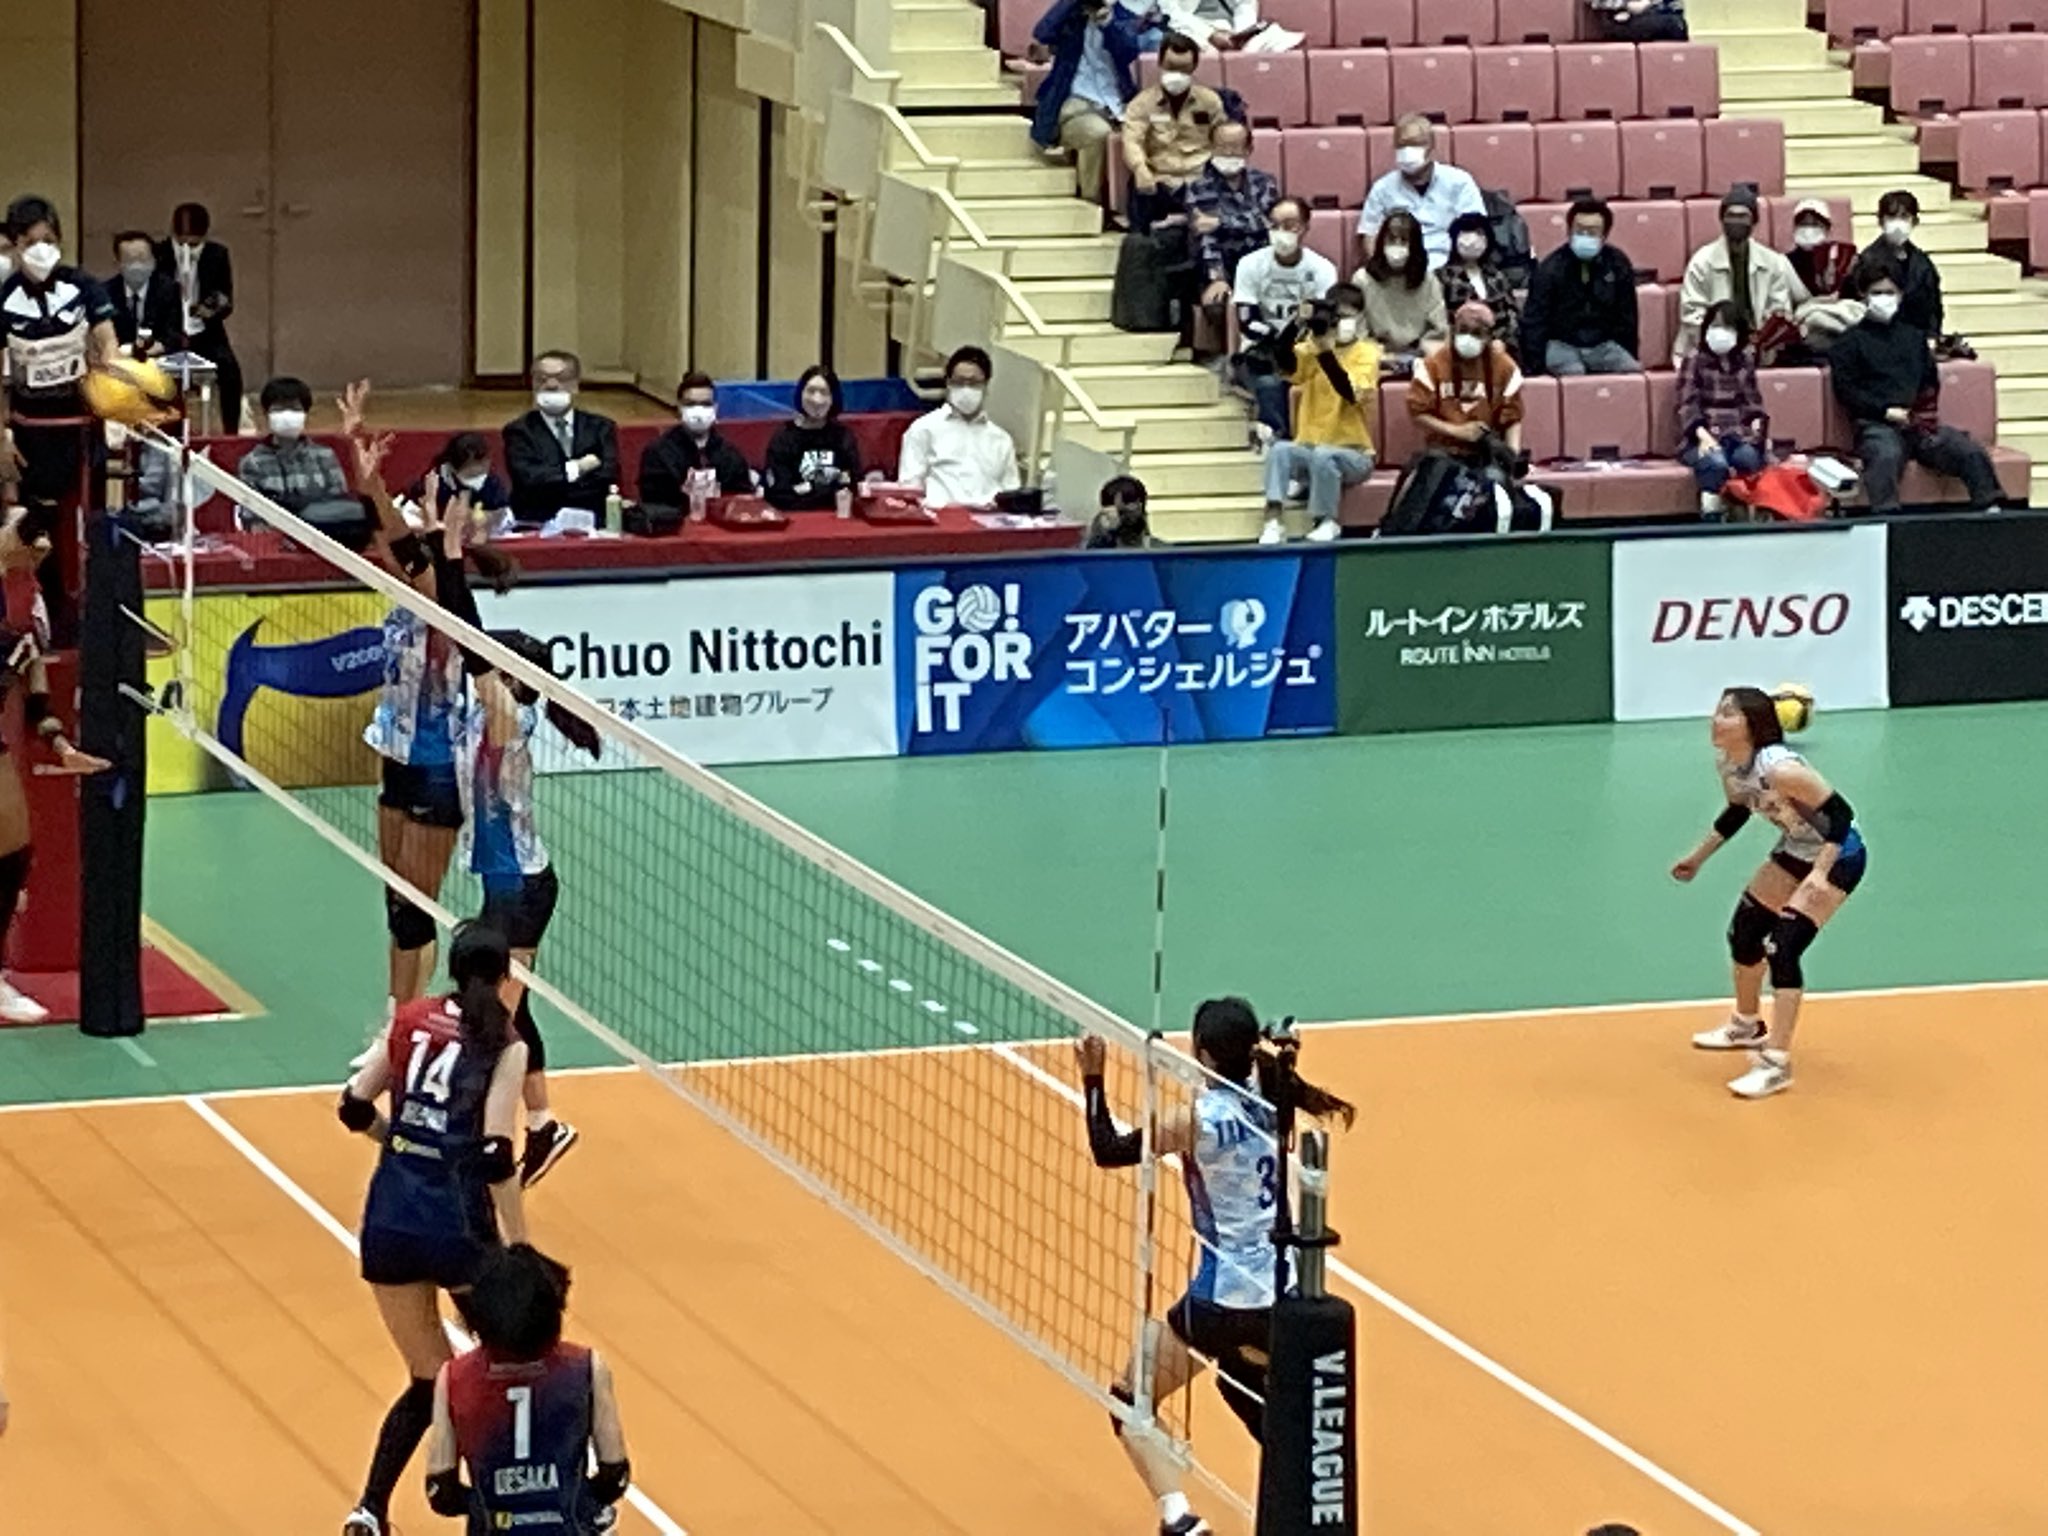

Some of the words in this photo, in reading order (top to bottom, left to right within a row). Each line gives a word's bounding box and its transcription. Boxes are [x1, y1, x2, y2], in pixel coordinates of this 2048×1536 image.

[914, 583, 1020, 634] GO!
[1065, 609, 1212, 653] アバター
[1652, 593, 1850, 644] DENSO
[1940, 591, 2048, 628] DESCE
[548, 631, 671, 681] Chuo
[689, 619, 883, 675] Nittochi
[915, 632, 1032, 682] FOR
[1400, 646, 1459, 666] ROUTE
[917, 682, 971, 732] IT
[405, 1029, 462, 1103] 14
[507, 1386, 531, 1459] 1
[1312, 1350, 1346, 1525] V.LEAGUE
